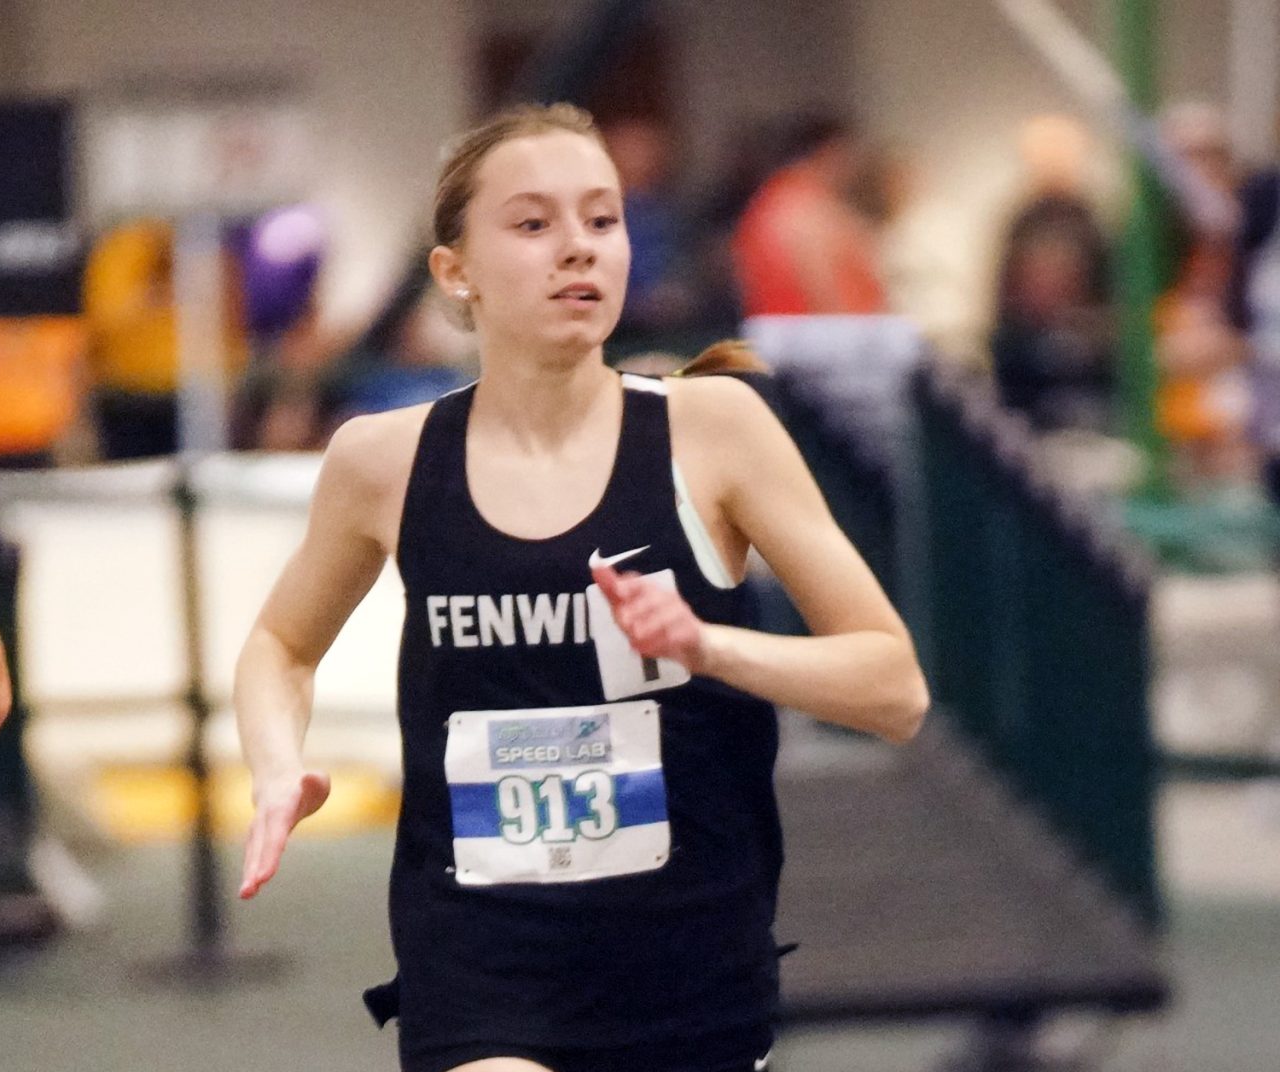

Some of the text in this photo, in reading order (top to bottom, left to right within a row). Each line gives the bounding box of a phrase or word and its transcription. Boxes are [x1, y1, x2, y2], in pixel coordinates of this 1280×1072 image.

[426, 592, 593, 648] FENWI
[495, 740, 609, 765] SPEED LAB
[496, 769, 618, 844] 913
